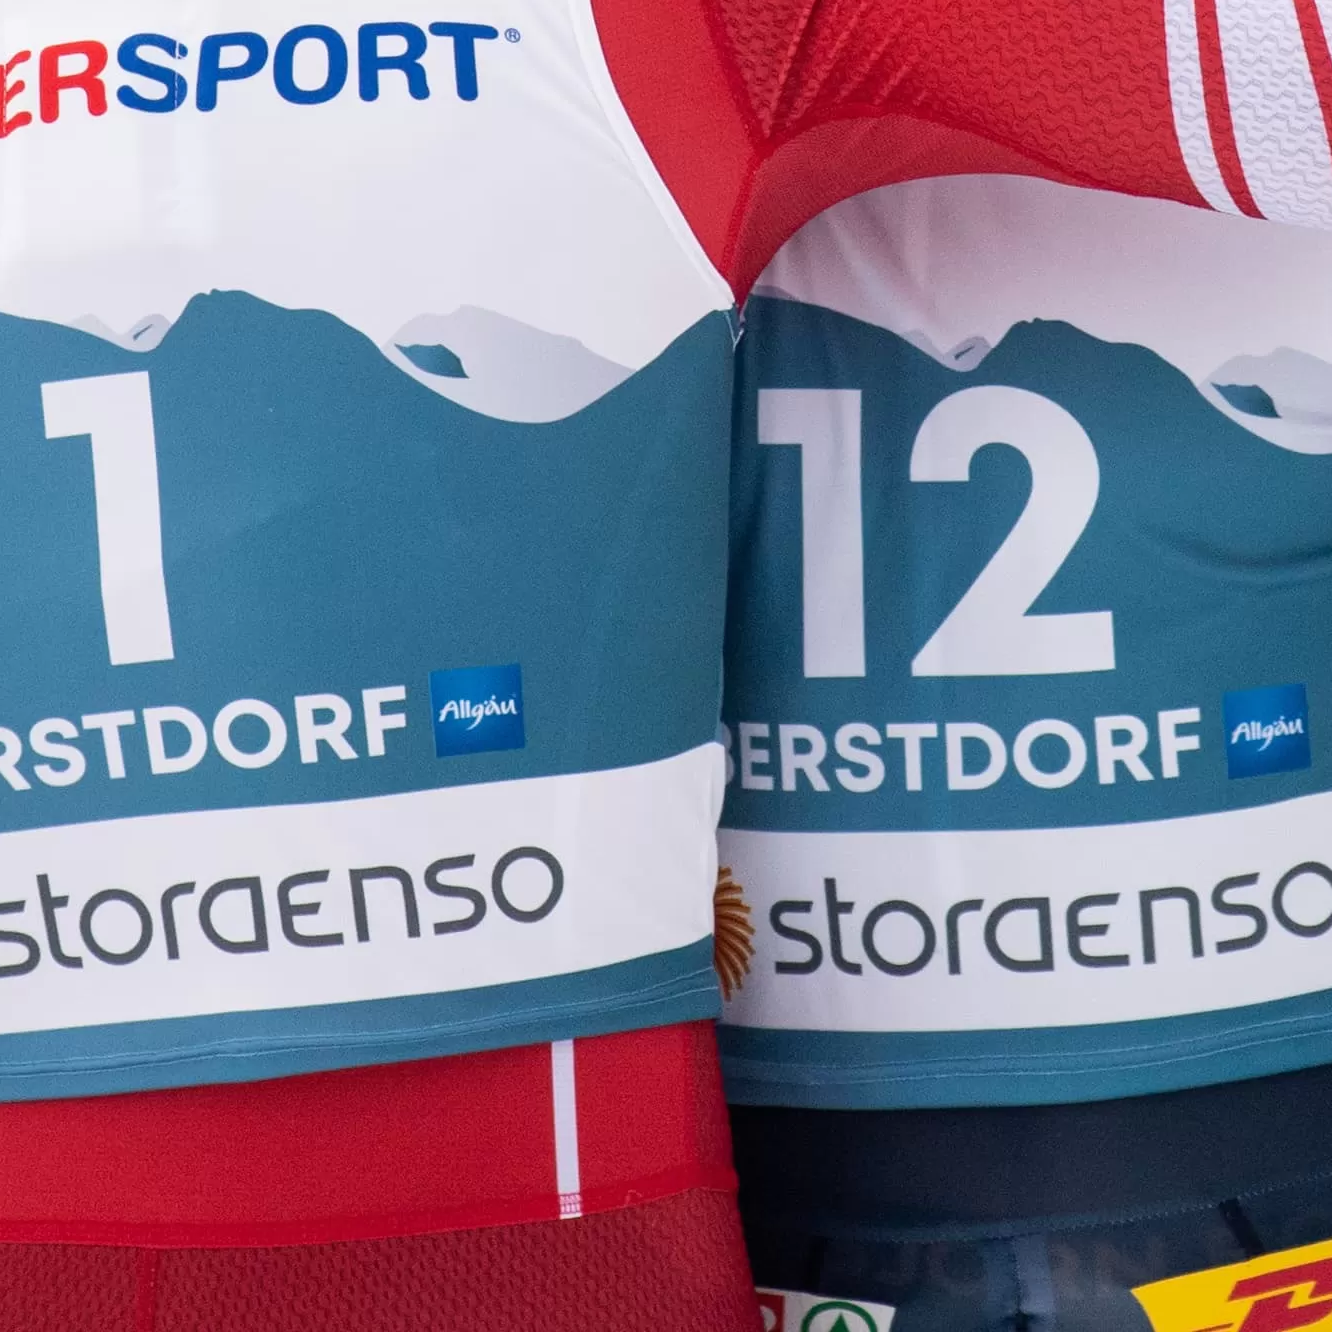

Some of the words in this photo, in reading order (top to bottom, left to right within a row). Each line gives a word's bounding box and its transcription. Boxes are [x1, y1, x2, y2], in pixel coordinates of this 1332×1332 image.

[40, 370, 175, 666] 1
[757, 384, 1116, 679] 12
[438, 694, 518, 731] Allgäu
[1230, 715, 1305, 752] Allgäu
